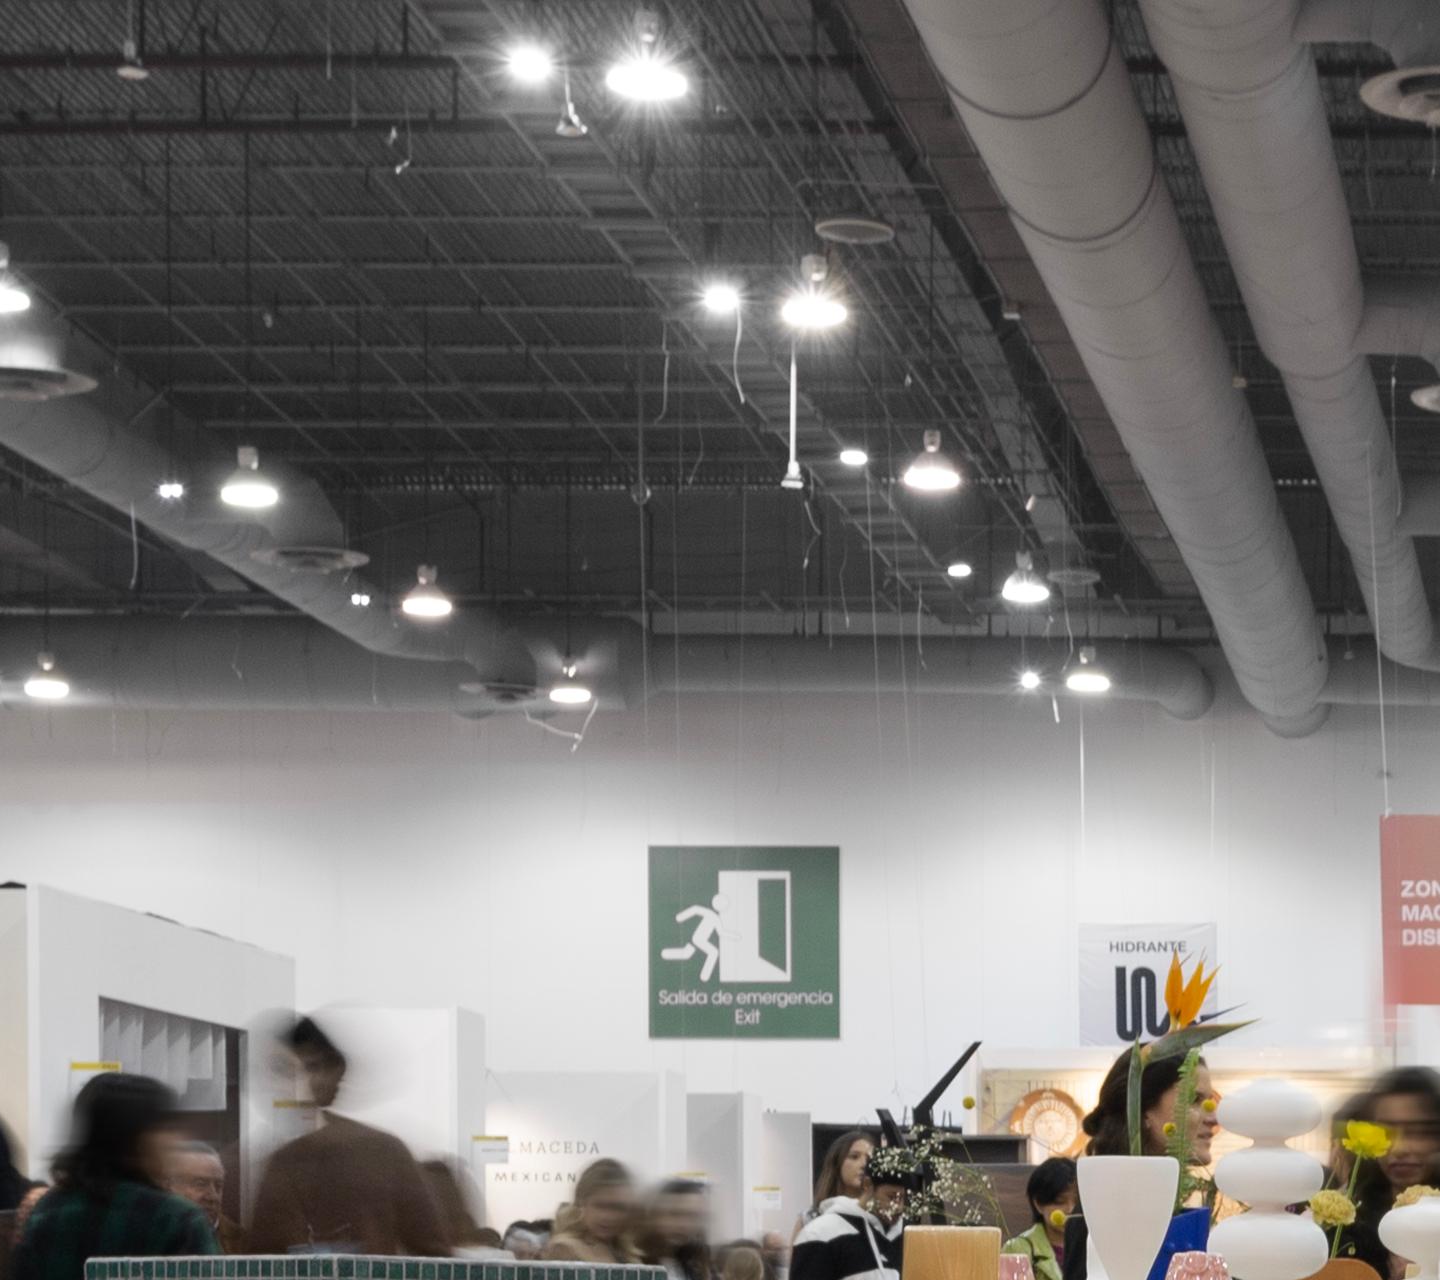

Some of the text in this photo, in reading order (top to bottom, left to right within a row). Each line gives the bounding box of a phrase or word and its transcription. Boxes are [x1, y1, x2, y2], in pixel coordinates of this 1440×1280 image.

[1110, 942, 1186, 952] HIDRANTE
[659, 991, 832, 1007] Salida de emergencia
[735, 1010, 760, 1024] Exit
[495, 1173, 576, 1182] MEXICAN
